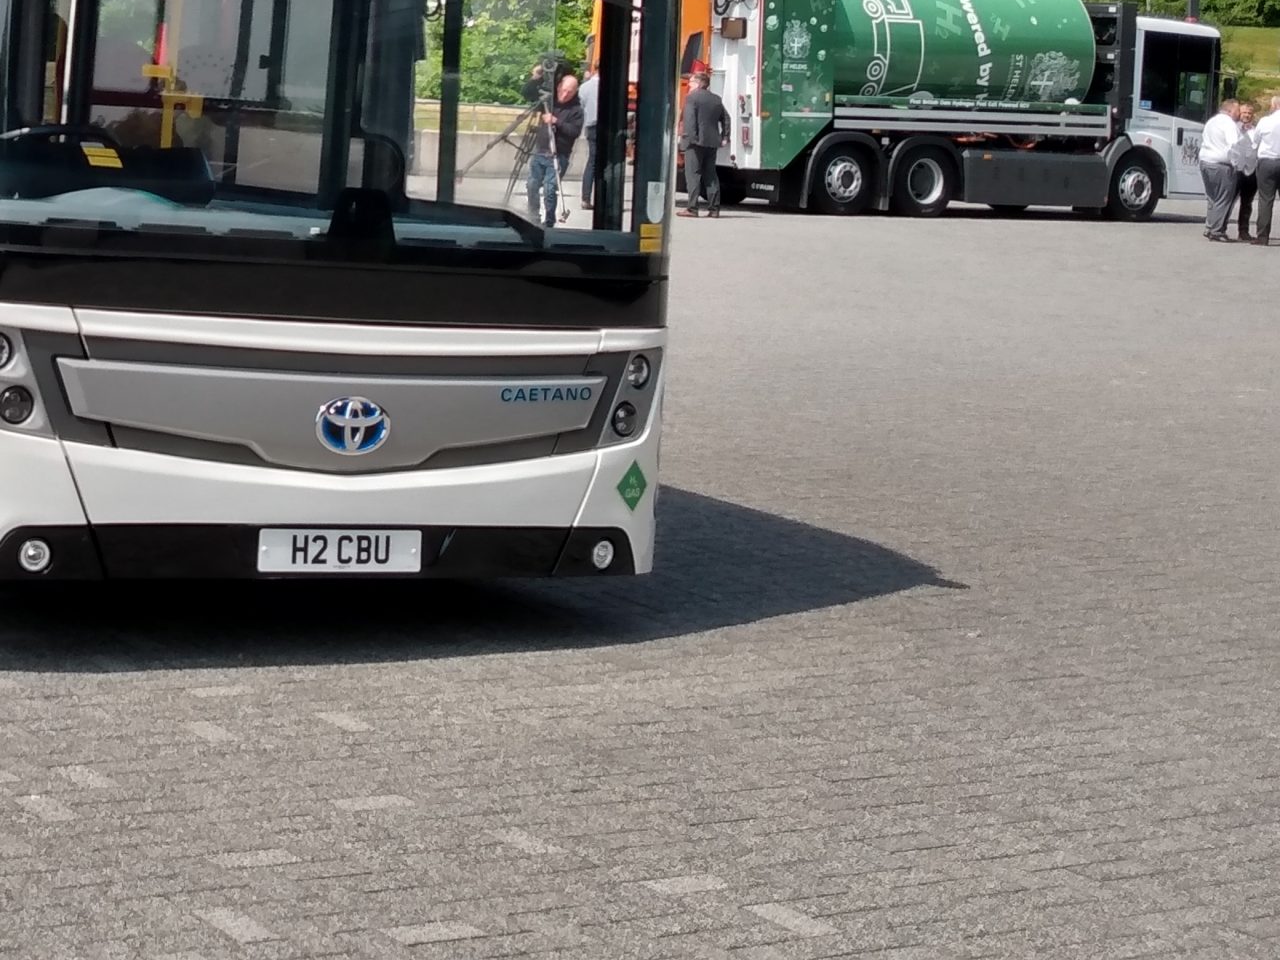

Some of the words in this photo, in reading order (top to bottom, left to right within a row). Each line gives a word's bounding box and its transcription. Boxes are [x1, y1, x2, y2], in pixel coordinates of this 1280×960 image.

[1015, 54, 1024, 68] ST
[976, 62, 993, 87] by
[952, 99, 975, 108] Hydrogen
[500, 386, 593, 403] CAETANO
[625, 487, 640, 498] GAS
[291, 534, 328, 565] H2
[337, 534, 391, 565] CBU
